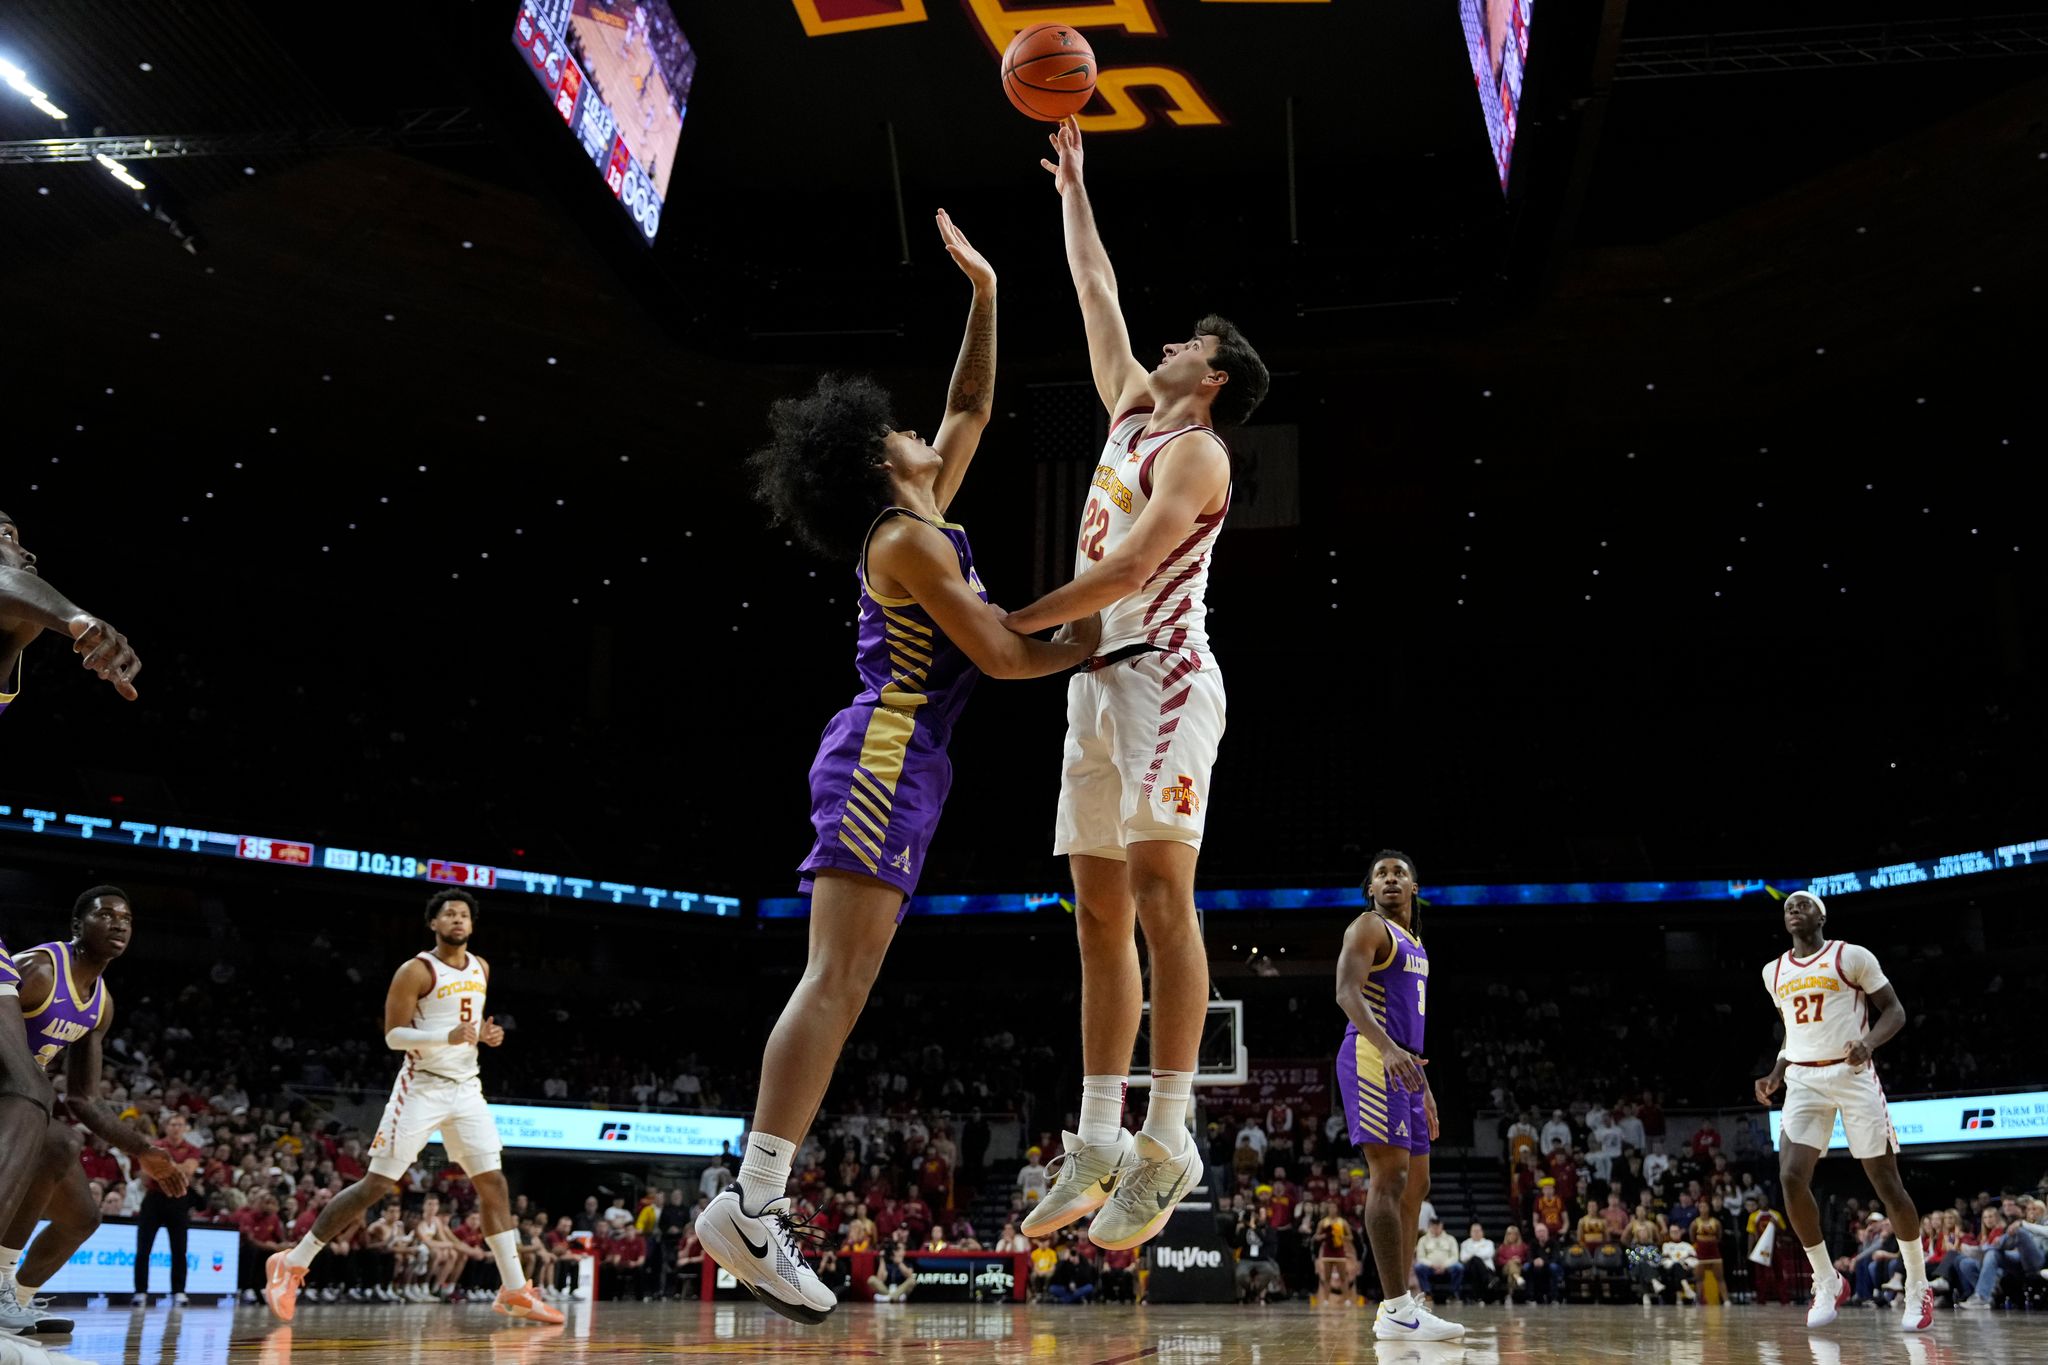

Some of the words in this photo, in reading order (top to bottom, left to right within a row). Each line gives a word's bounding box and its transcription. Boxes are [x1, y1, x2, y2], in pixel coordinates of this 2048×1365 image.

[1080, 497, 1110, 562] 22
[242, 838, 273, 860] 35
[358, 851, 417, 878] 10:13
[464, 865, 490, 887] 13
[1417, 979, 1426, 1016] 3
[1777, 975, 1840, 998] CYCLONES
[460, 998, 472, 1022] 5
[1793, 993, 1825, 1024] 27
[2000, 1106, 2030, 1117] FARM
[2034, 1103, 2048, 1114] BU
[1894, 1124, 1923, 1135] VICES
